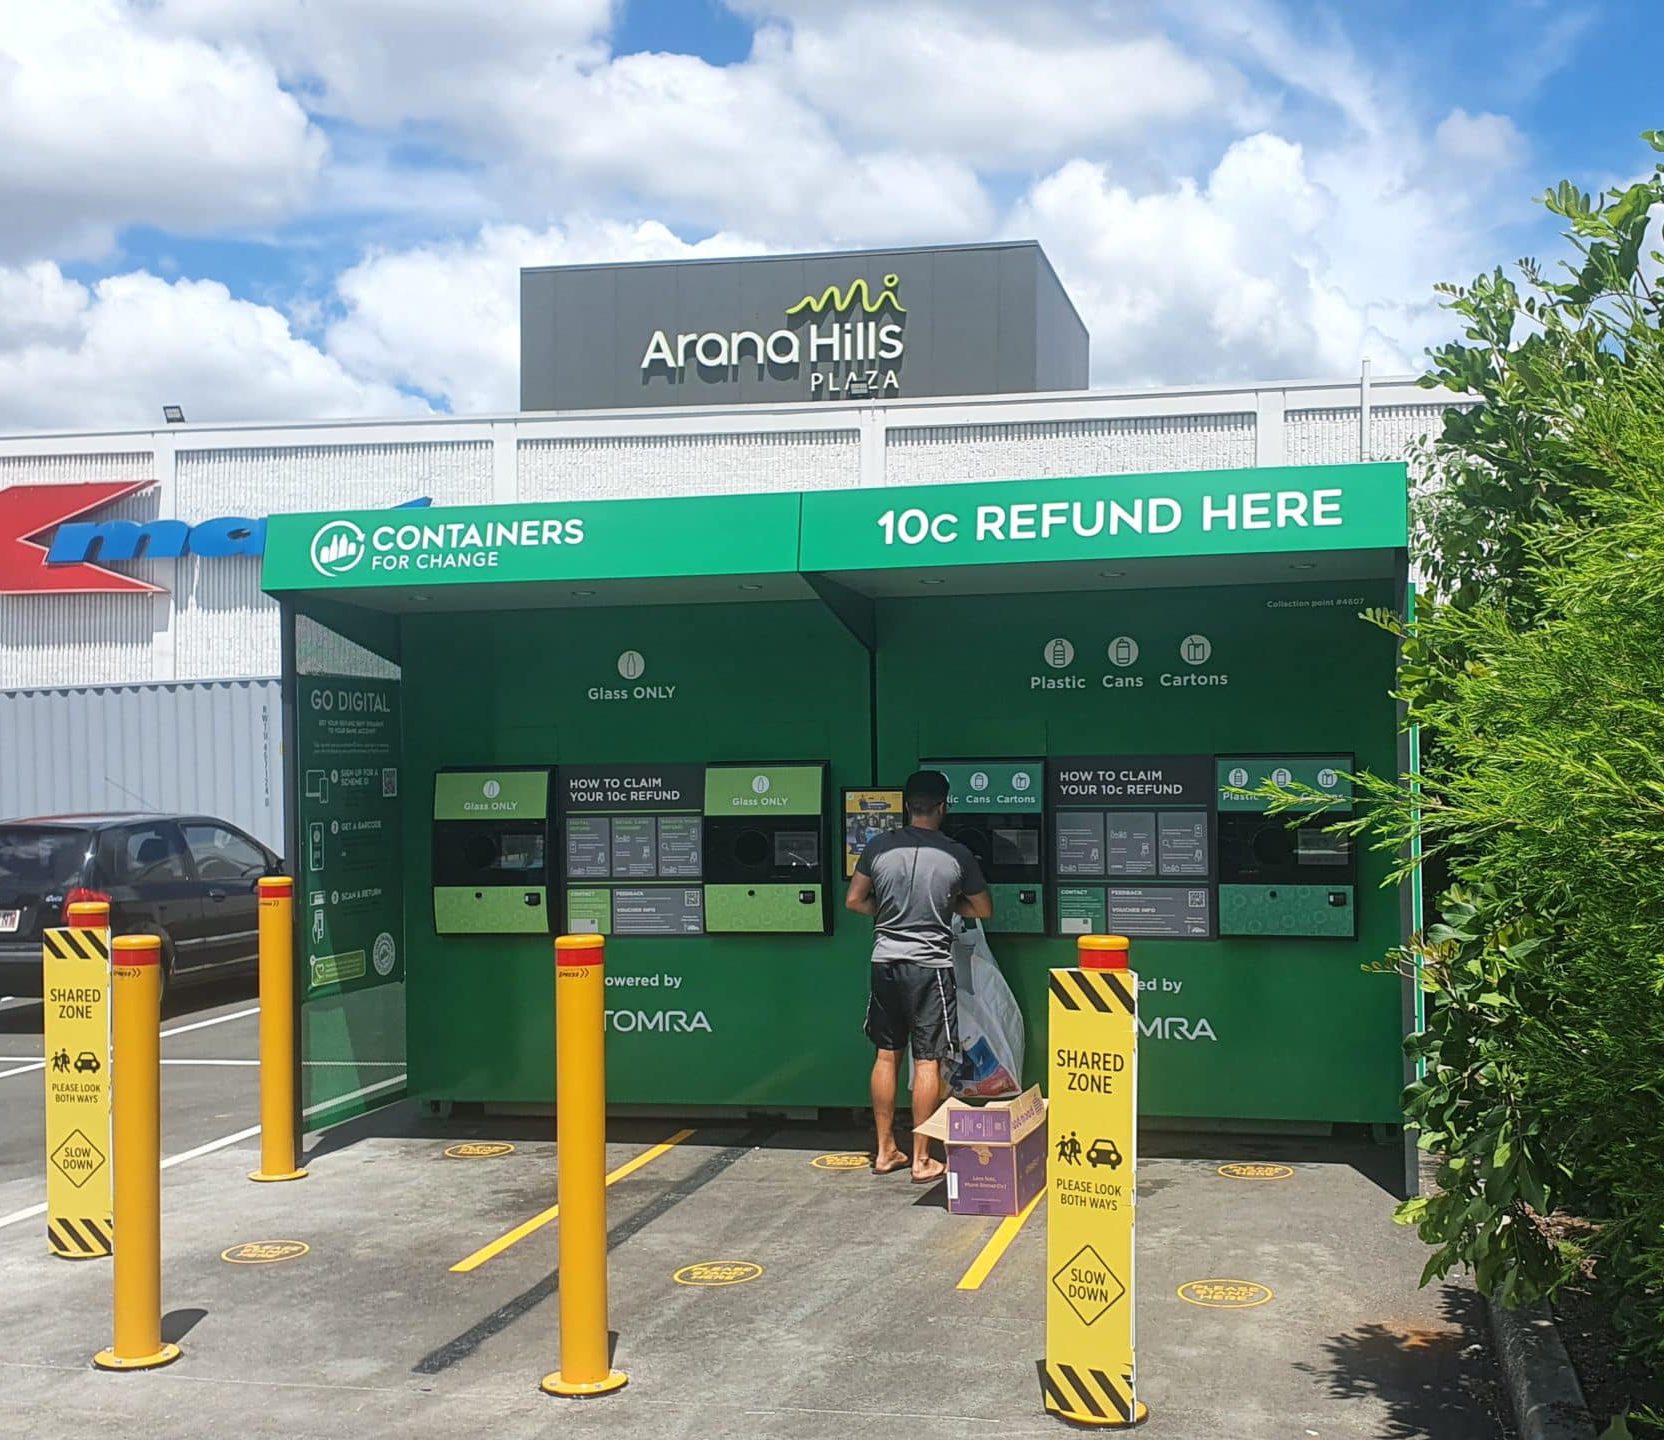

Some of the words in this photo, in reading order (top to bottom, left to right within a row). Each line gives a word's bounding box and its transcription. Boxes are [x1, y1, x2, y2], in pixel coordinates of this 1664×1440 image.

[640, 329, 800, 369] Arana
[809, 321, 904, 362] Hills
[810, 369, 900, 393] PLAZA
[876, 508, 958, 545] 10c
[975, 497, 1182, 542] REFUND
[1201, 488, 1344, 532] HERE
[371, 517, 585, 551] CONTAINERS
[371, 554, 410, 571] FOR
[415, 551, 499, 570] CHANGE
[1266, 599, 1310, 608] Collection
[1311, 599, 1334, 608] point
[1030, 674, 1087, 690] Plastic
[1101, 673, 1144, 689] Cans
[1159, 671, 1228, 688] Cartons
[310, 689, 334, 711] GO
[587, 687, 628, 701] Glass
[632, 686, 676, 699] ONLY
[569, 778, 601, 789] HOW
[603, 778, 620, 789] TO
[623, 777, 662, 788] CLAIM
[1060, 770, 1093, 782] HOW
[1096, 770, 1116, 782] TO
[1119, 770, 1163, 781] CLAIM
[569, 791, 604, 802] YOUR
[607, 791, 627, 801] 10c
[629, 790, 681, 801] REFUND
[1060, 784, 1097, 795] YOUR
[1101, 784, 1123, 795] 10c
[1127, 784, 1183, 795] REFUND
[463, 801, 489, 811] Glass
[491, 801, 518, 811] ONLY
[731, 796, 759, 806] Glass
[760, 796, 789, 806] ONLY
[965, 795, 991, 804] Cans
[996, 794, 1036, 804] Cartons
[604, 974, 659, 987] owered
[663, 974, 683, 989] by
[1162, 978, 1183, 994] by
[50, 988, 102, 1002] SHARED
[58, 1004, 93, 1019] ZONE
[1056, 1048, 1125, 1073] SHARED
[51, 1083, 80, 1093] PLEASE
[80, 1083, 101, 1093] LOOK
[1067, 1072, 1113, 1095] ZONE
[55, 1094, 76, 1104] BOTH
[77, 1094, 99, 1104] WAYS
[64, 1147, 92, 1158] SLOW
[62, 1159, 94, 1171] DOWN
[1056, 1178, 1092, 1194] PLEASE
[1094, 1181, 1122, 1197] LOOK
[1060, 1193, 1087, 1208] BOTH
[1089, 1196, 1119, 1211] WAYS
[1070, 1268, 1106, 1286] SLOW
[1067, 1284, 1109, 1304] DOWN
